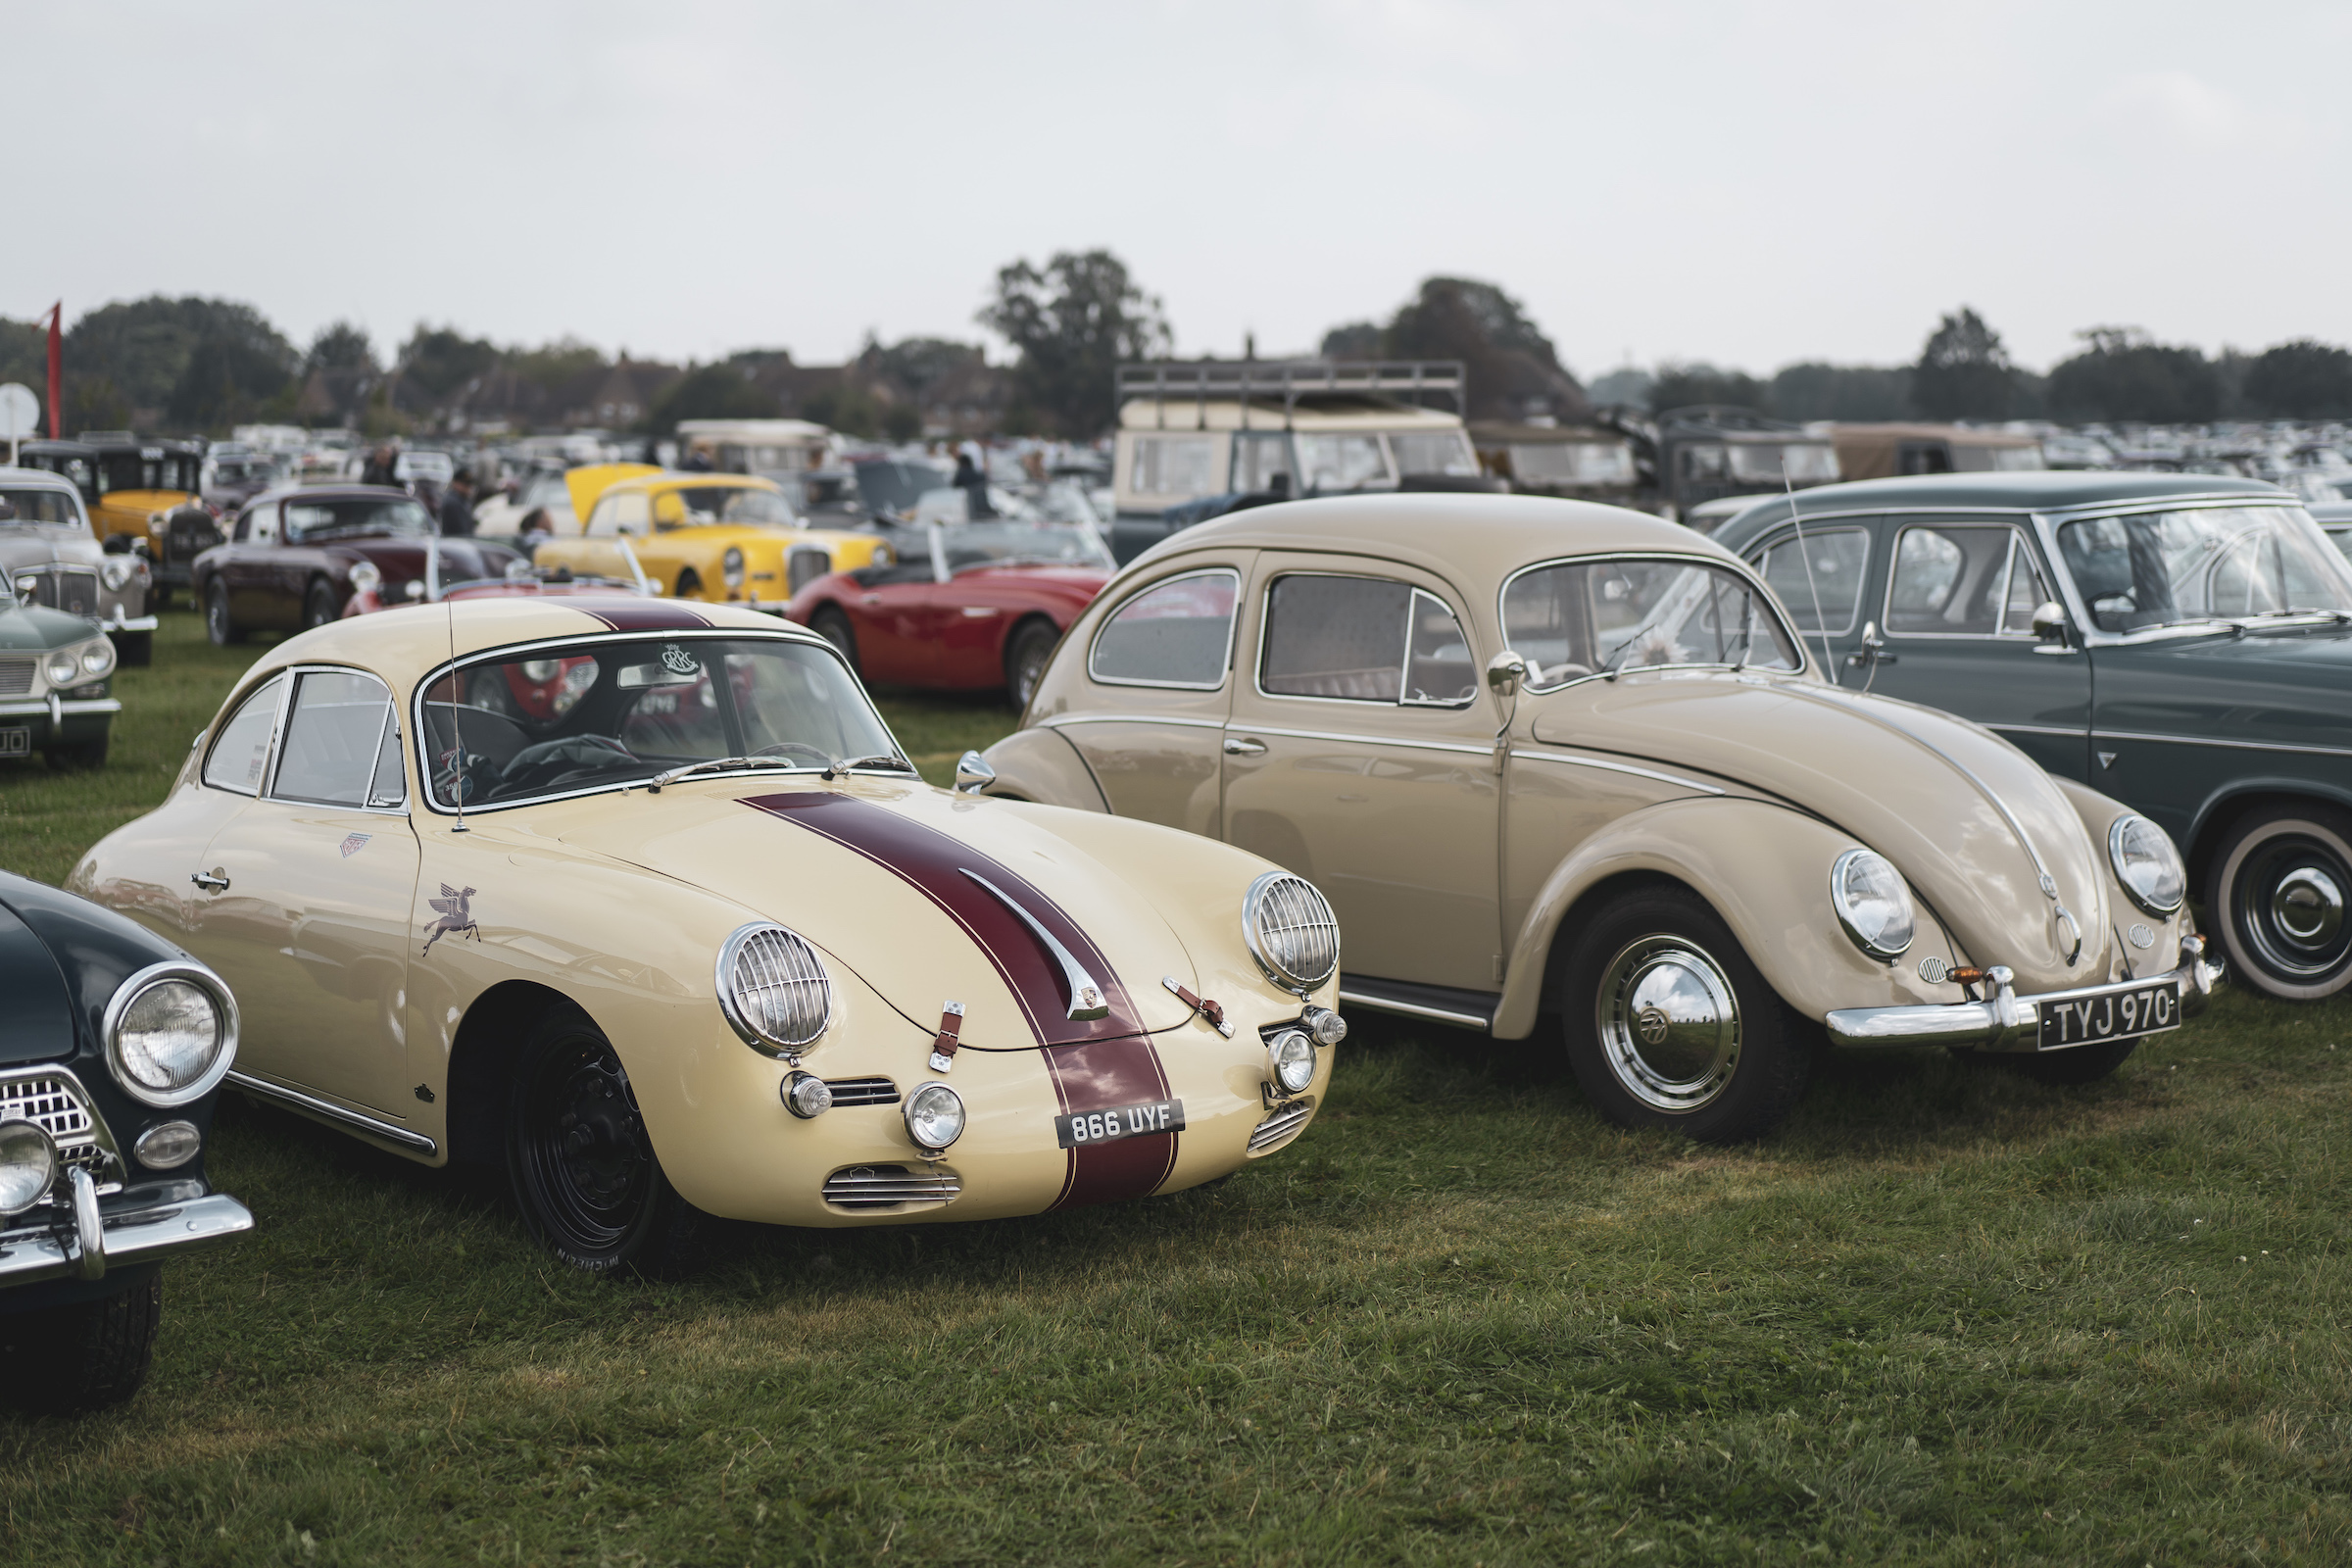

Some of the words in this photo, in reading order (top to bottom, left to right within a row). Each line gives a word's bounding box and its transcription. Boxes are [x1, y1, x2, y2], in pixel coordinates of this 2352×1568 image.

[662, 650, 695, 668] GRRC
[2054, 998, 2113, 1042] TYJ
[2121, 988, 2170, 1031] 970
[1071, 1110, 1121, 1142] 866
[1127, 1103, 1170, 1133] UYF
